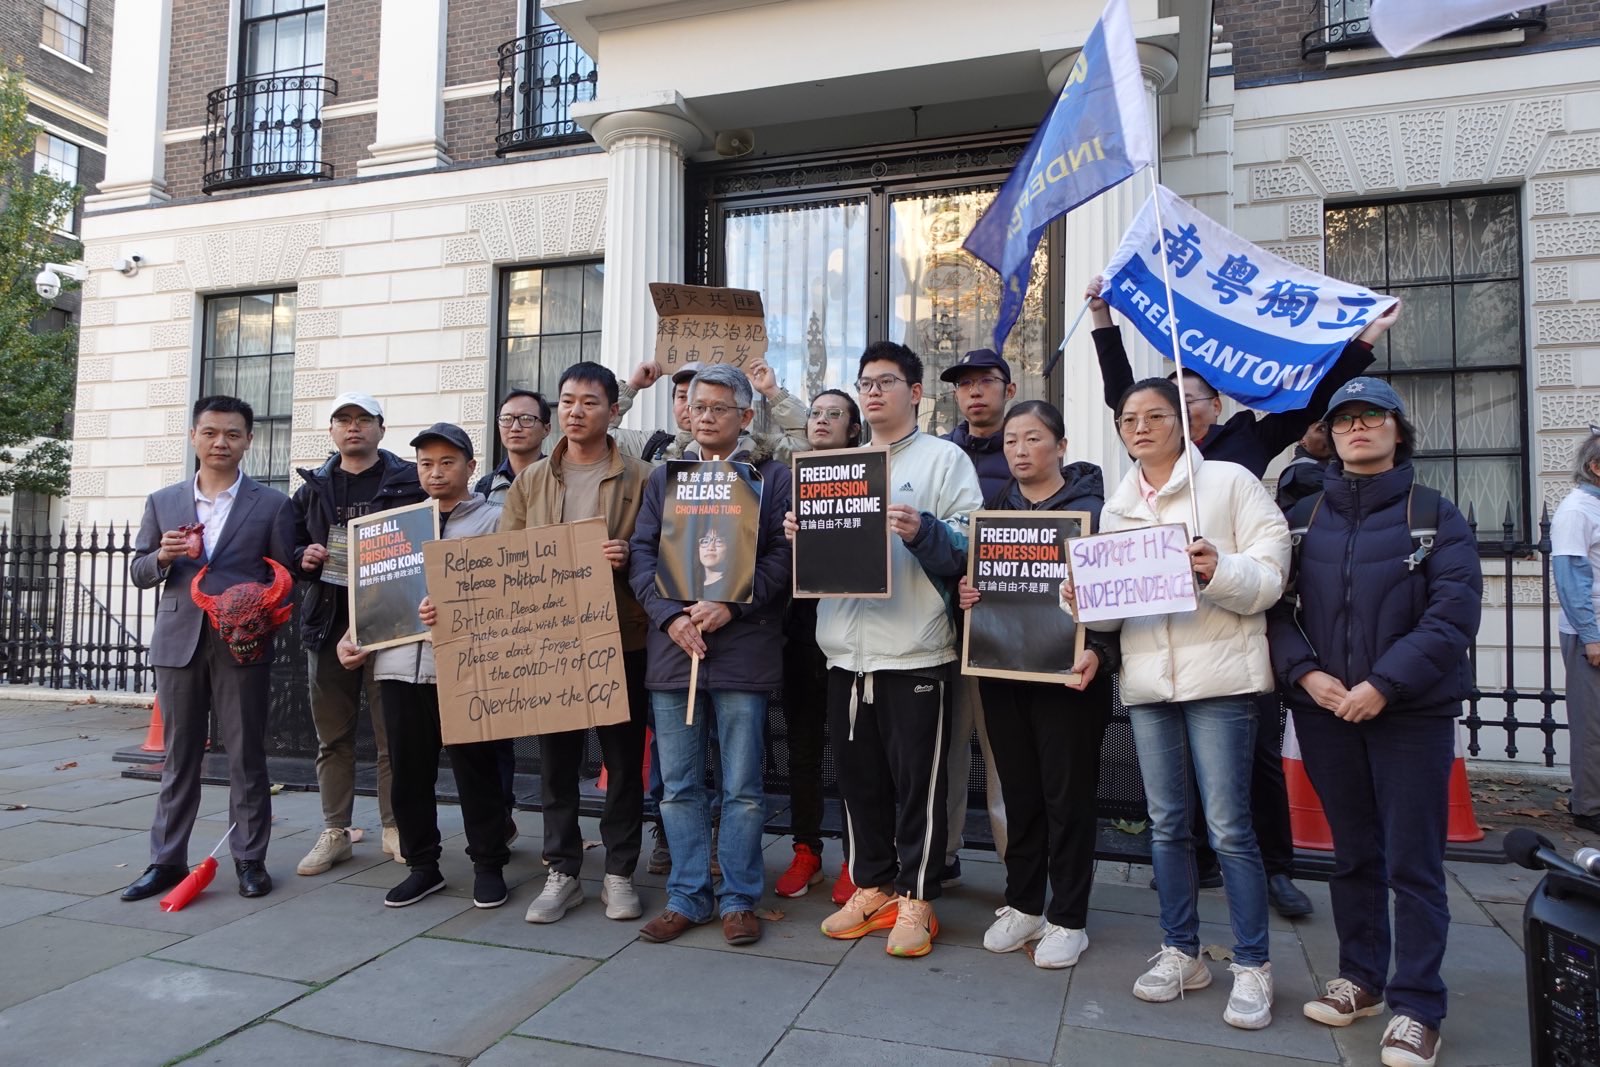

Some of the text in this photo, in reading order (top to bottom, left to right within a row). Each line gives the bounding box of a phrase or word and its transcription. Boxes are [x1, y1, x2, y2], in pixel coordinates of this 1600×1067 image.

[656, 288, 758, 310] 消灭共匪
[1119, 278, 1180, 336] FREE
[658, 318, 767, 342] 释放政治犯
[668, 344, 750, 367] 自由万岁
[800, 464, 865, 482] FREEDOM OF
[677, 484, 731, 500] RELEASE
[800, 481, 868, 498] EXPRESSION
[676, 505, 741, 514] CHOW HANG TUNG
[800, 497, 880, 515] IS NOT A CRIME
[360, 519, 399, 539] FREE ALL
[800, 518, 861, 529] 言論自由不是罪
[360, 531, 406, 552] POLITICAL
[980, 528, 1057, 543] FREEDOM OF
[1144, 530, 1182, 559] HK
[360, 542, 412, 565] PRISONERS
[445, 541, 556, 578] Release Jimmy Lai
[980, 545, 1058, 561] EXPRESSION
[360, 552, 424, 578] IN HONG KONG
[979, 561, 991, 576] IS
[993, 561, 1019, 577] NOT
[1021, 562, 1030, 578] A
[456, 574, 496, 597] release
[978, 581, 1049, 593] 言論自由不是罪
[1076, 571, 1194, 610] INDEPENDENCE
[471, 602, 613, 643] make a deal with the devil
[540, 638, 581, 659] forget
[489, 647, 616, 681] the COVID-19 of CCP
[557, 686, 584, 707] the
[587, 680, 620, 708] CCP
